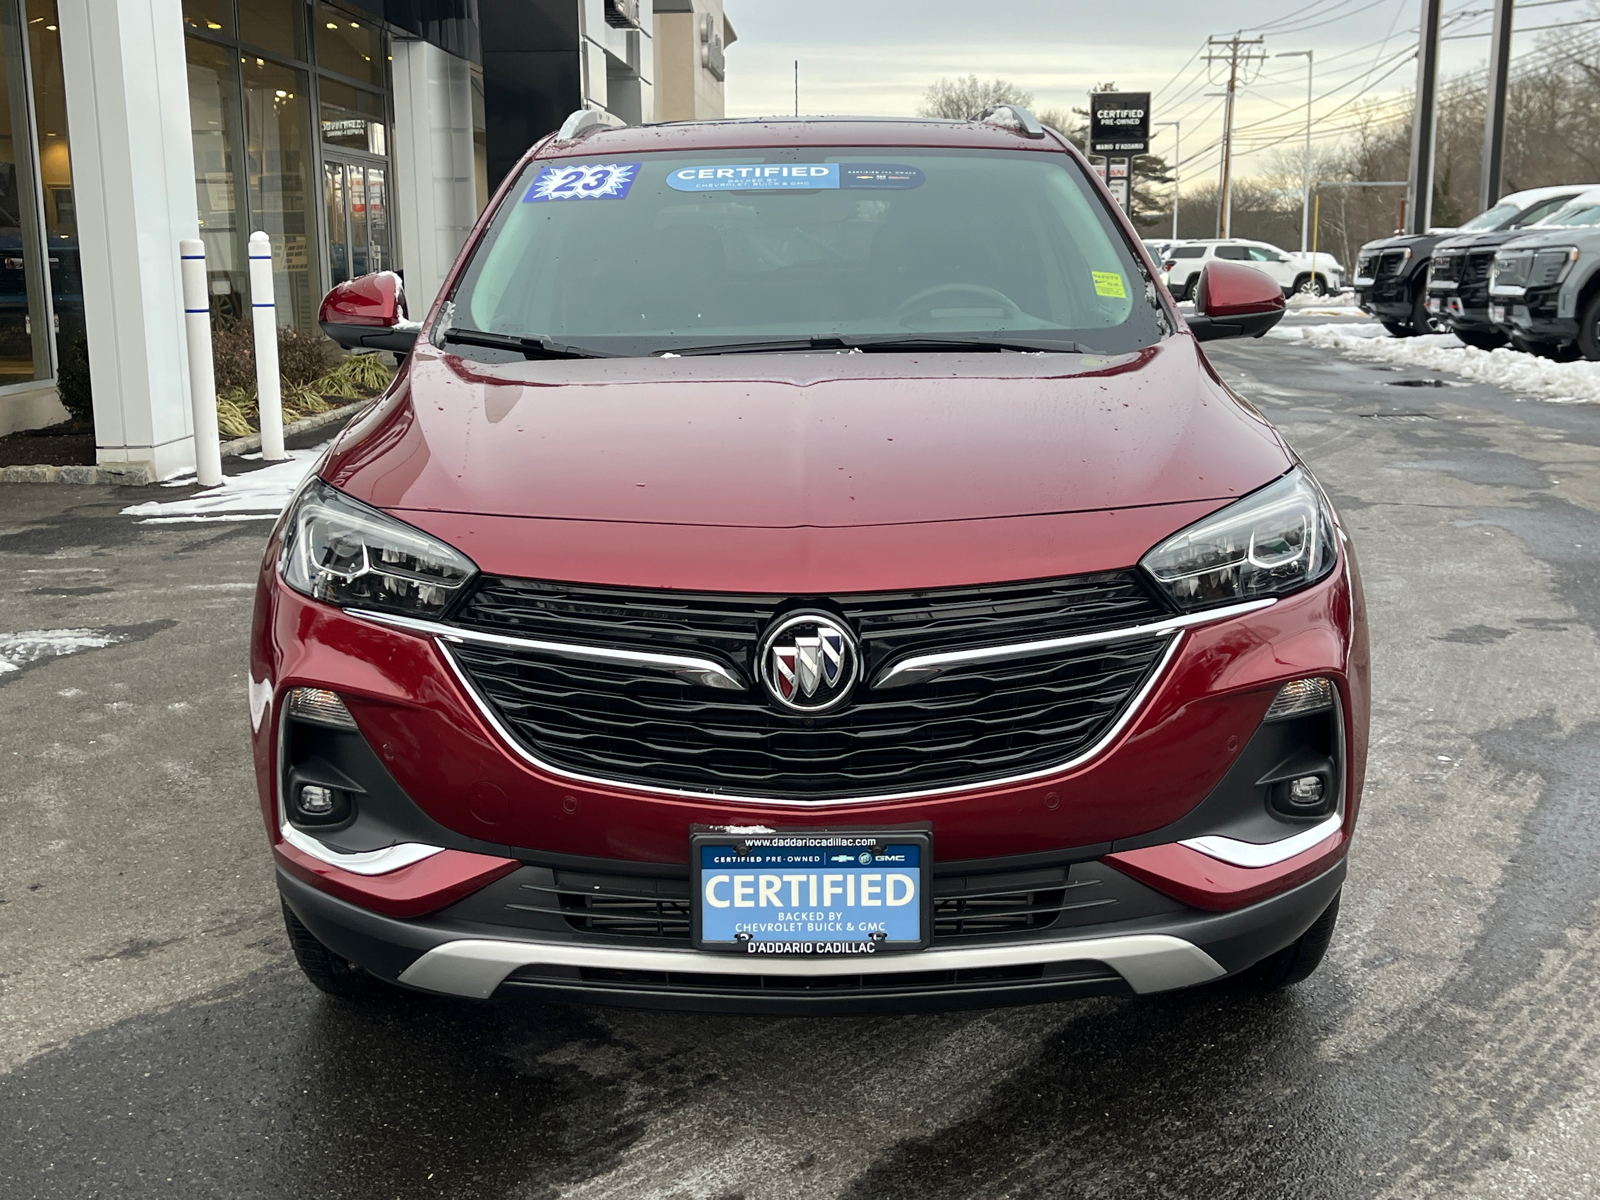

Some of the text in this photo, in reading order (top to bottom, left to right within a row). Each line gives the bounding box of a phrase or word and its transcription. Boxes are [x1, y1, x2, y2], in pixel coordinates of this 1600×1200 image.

[1097, 109, 1144, 119] CERTIFIED
[1100, 118, 1140, 126] PRE-OWNED
[677, 166, 829, 180] CERTIFIED
[551, 169, 611, 193] 23
[745, 837, 876, 848] www.daddariocadillac.com
[714, 855, 821, 863] CERTIFIED PRE-OWNED
[875, 854, 905, 862] GMC
[705, 873, 915, 909] CERTIFIED
[778, 912, 843, 921] BACKED BY
[735, 921, 886, 932] CHEVROLET BUICK & GMC
[747, 941, 876, 954] D'ADDARIO CADILLAC
